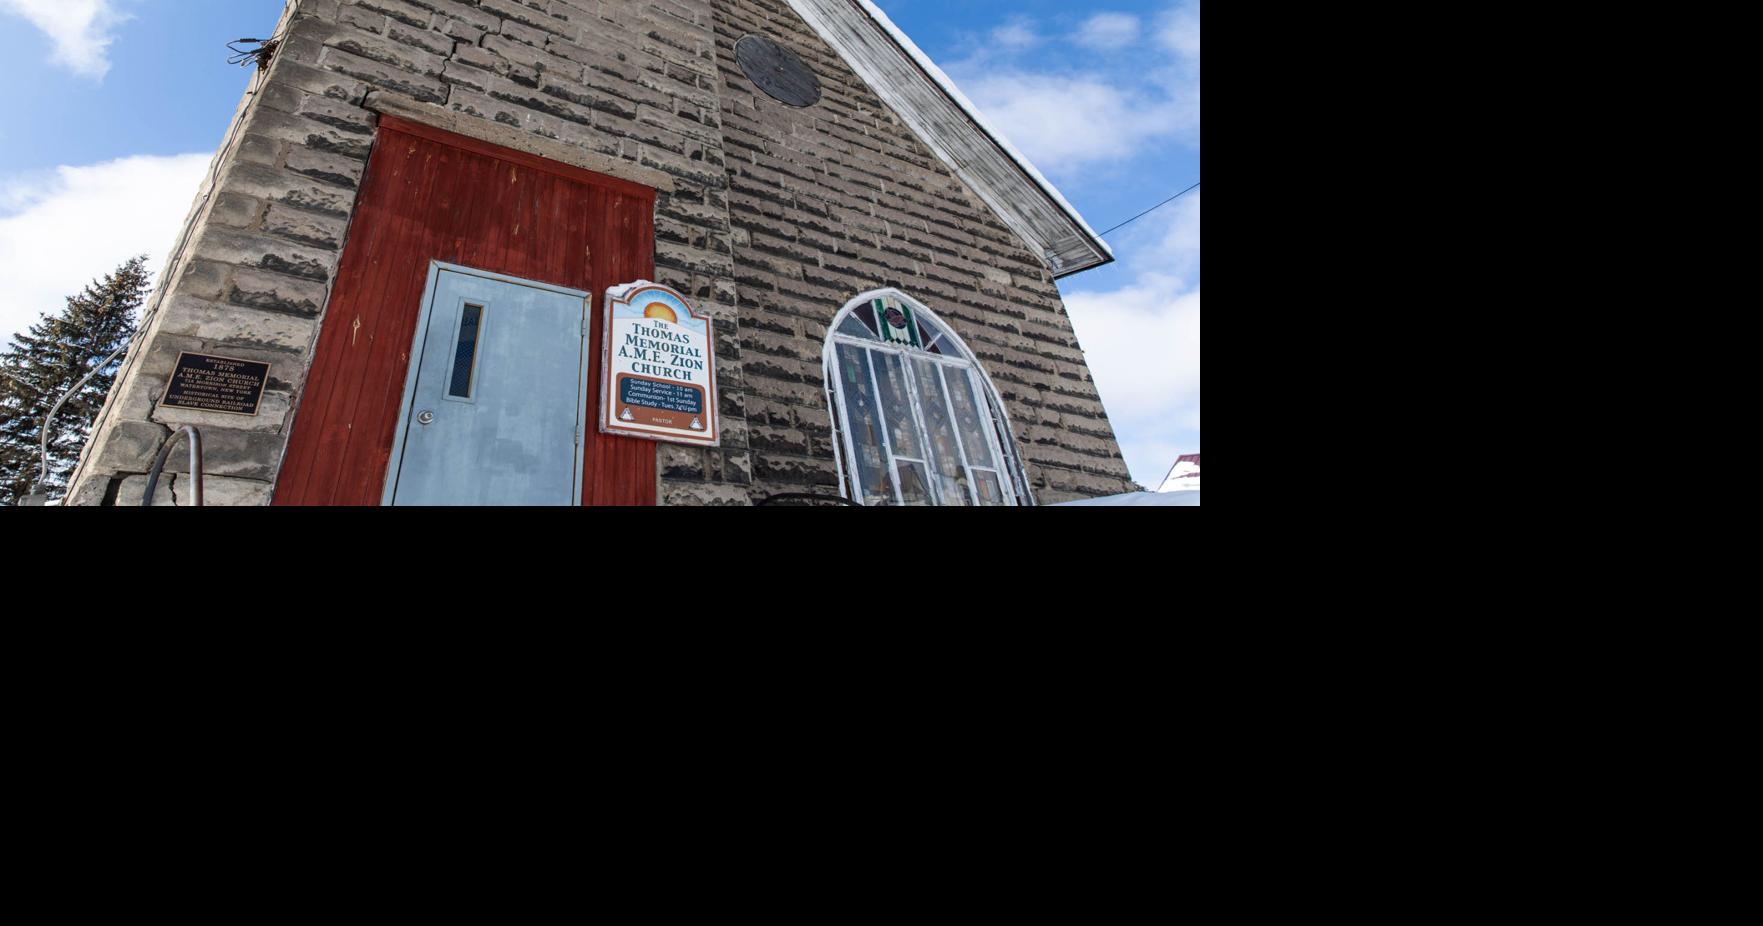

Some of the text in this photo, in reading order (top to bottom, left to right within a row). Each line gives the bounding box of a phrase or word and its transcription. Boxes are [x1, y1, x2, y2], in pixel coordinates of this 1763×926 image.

[654, 320, 668, 329] THE
[632, 323, 689, 343] THOMAS
[626, 334, 701, 357] MEMORIAL
[618, 345, 703, 370] A.M.E. ZION
[218, 372, 259, 381] MEMORIAL
[632, 362, 691, 380] CHURCH
[169, 395, 220, 404] UNDERGROUND
[676, 398, 696, 406] Sunday
